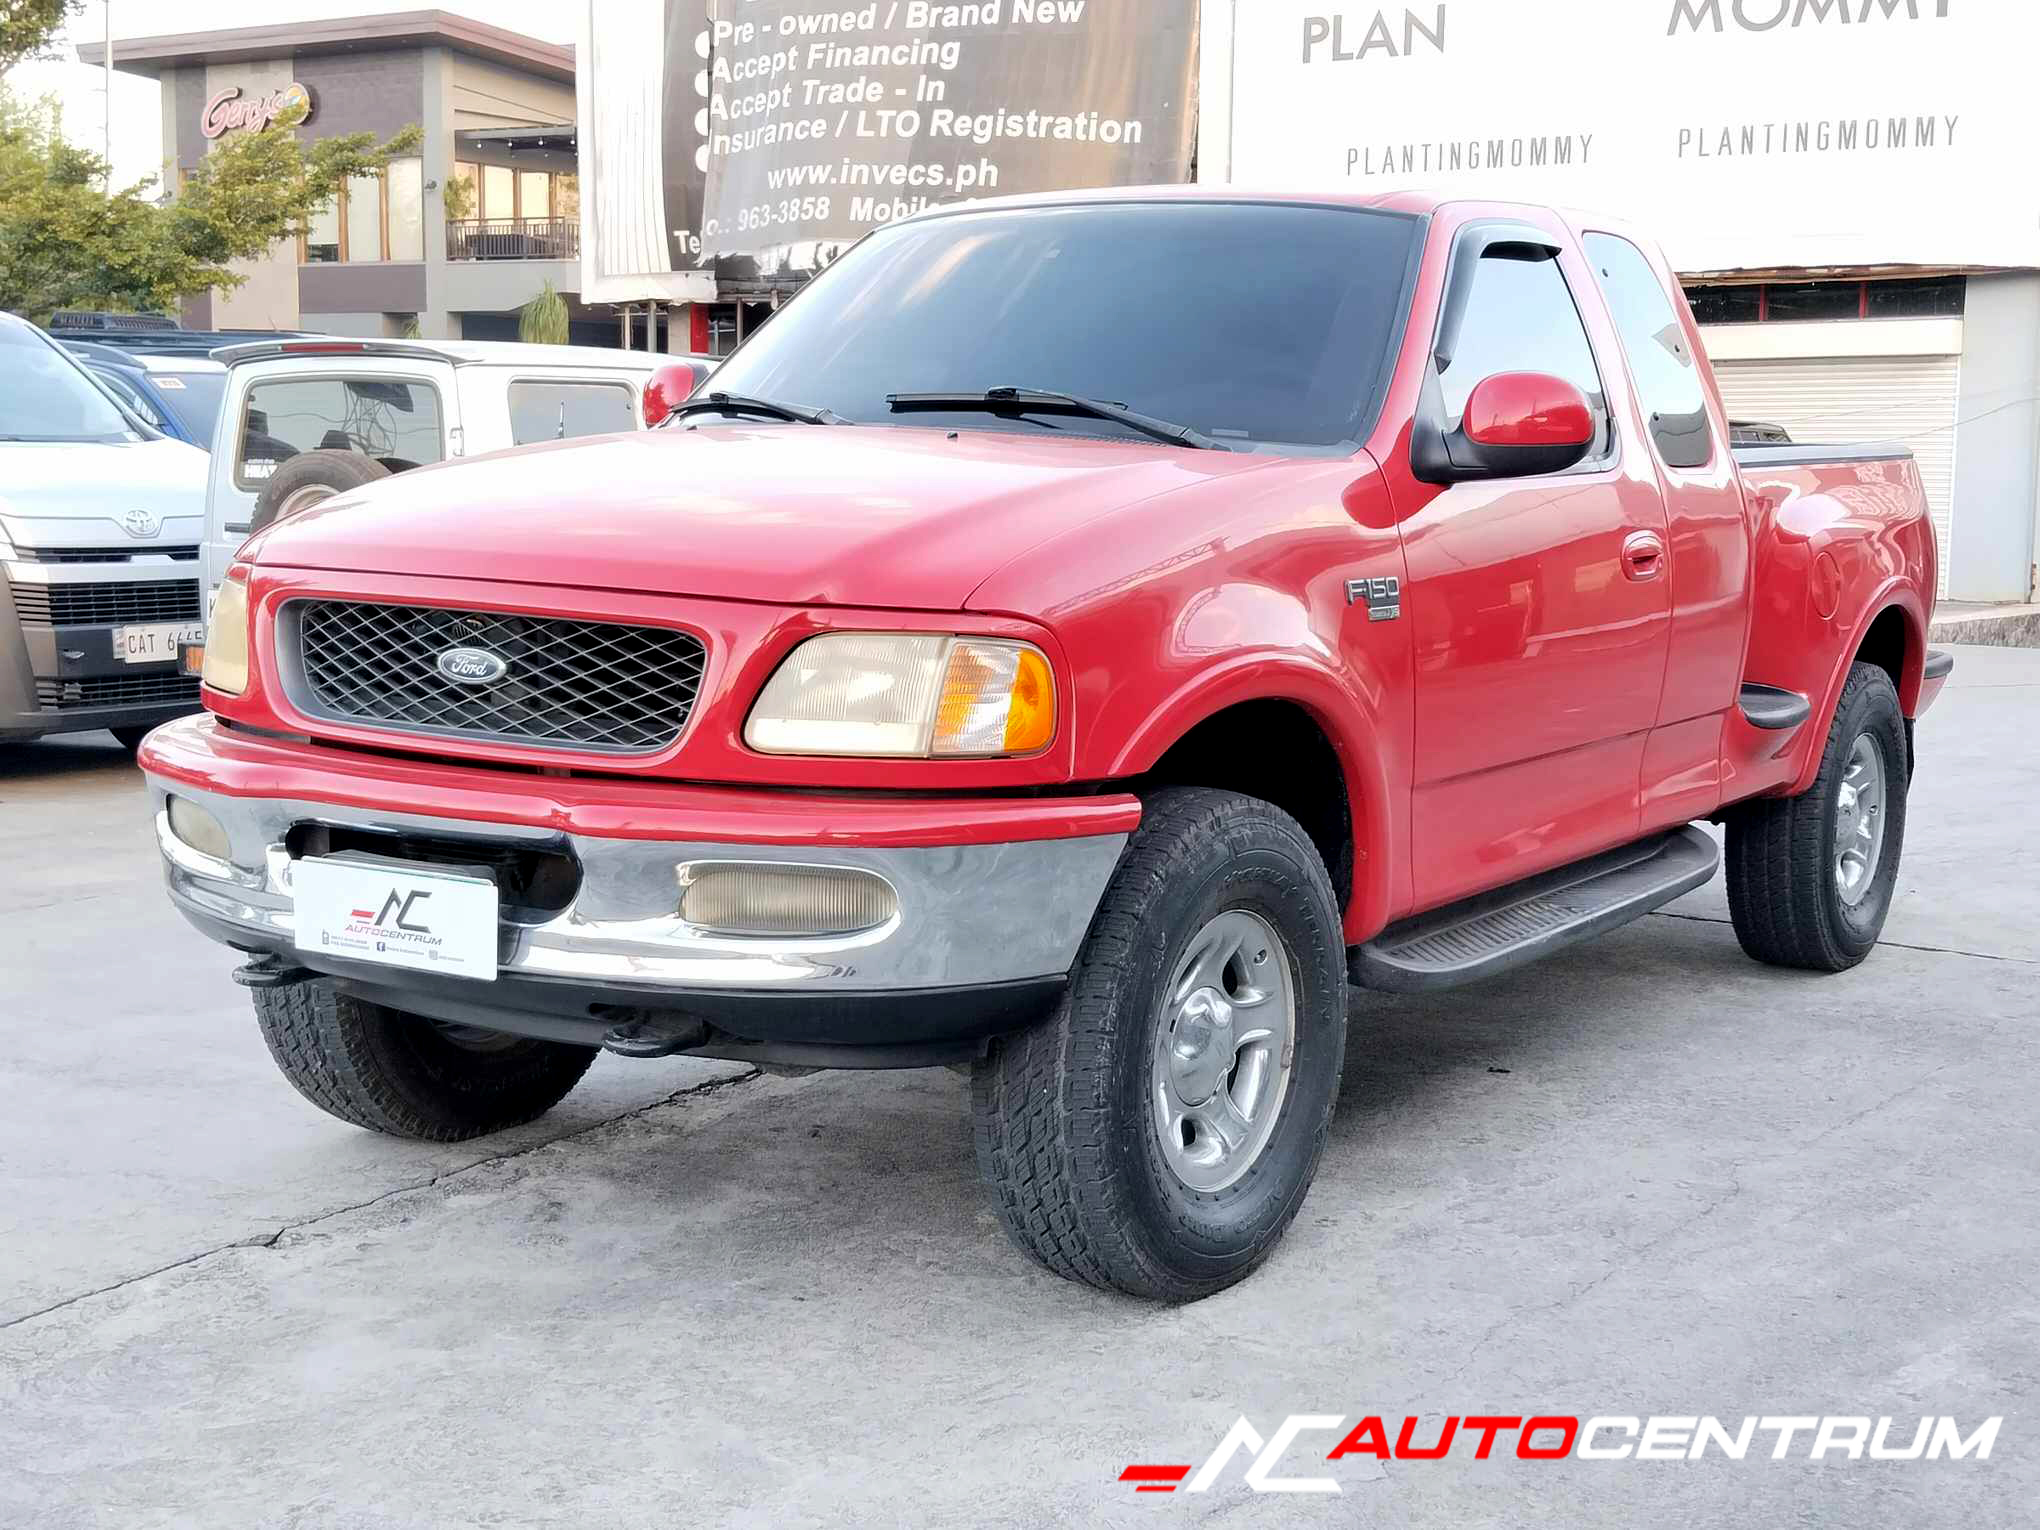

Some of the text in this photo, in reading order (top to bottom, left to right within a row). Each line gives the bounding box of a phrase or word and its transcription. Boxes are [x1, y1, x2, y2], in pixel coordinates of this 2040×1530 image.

[714, 20, 755, 47] Pre
[779, 3, 877, 36] owned
[884, 2, 898, 29] /
[905, 0, 1000, 29] Brand
[1011, 0, 1085, 24] New
[1302, 3, 1447, 64] PLAN
[1666, 0, 1950, 36] MOMM
[713, 38, 961, 83] Accept Financing
[711, 84, 792, 120] Accept
[802, 76, 884, 105] Trade
[916, 75, 945, 102] In
[708, 108, 1142, 154] nsurance / LTO Registration
[1678, 115, 1959, 158] PLANTINGMOMMY
[767, 157, 998, 192] www.invecs.ph
[1346, 134, 1593, 176] PLANTINGMOMMY
[738, 196, 830, 232] 963-3858
[128, 633, 155, 654] CAT
[451, 653, 489, 676] Ford
[344, 924, 443, 946] AUTOCENTRUM
